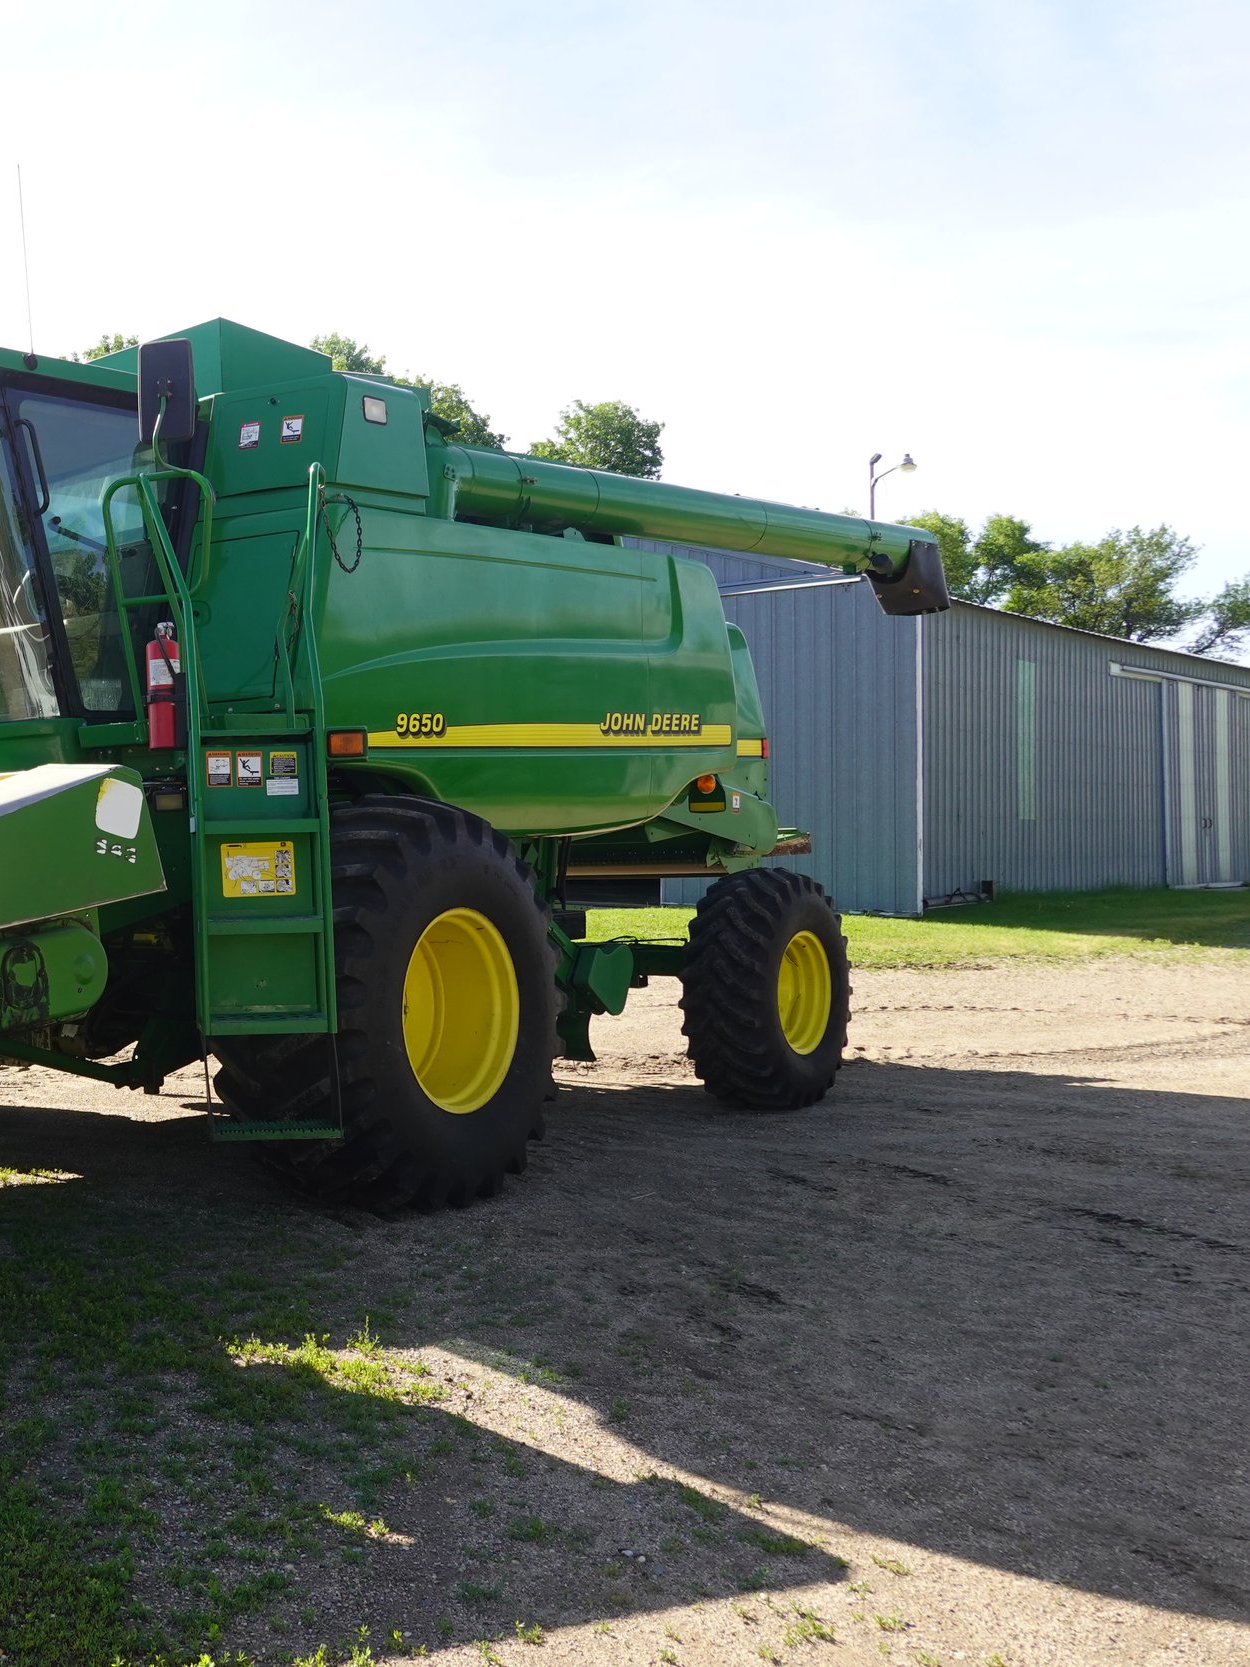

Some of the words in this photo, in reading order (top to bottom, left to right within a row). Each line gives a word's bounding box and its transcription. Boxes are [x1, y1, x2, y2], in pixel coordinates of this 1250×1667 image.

[395, 712, 446, 736] 9650
[599, 711, 647, 735] JOHN
[651, 712, 701, 735] DEERE
